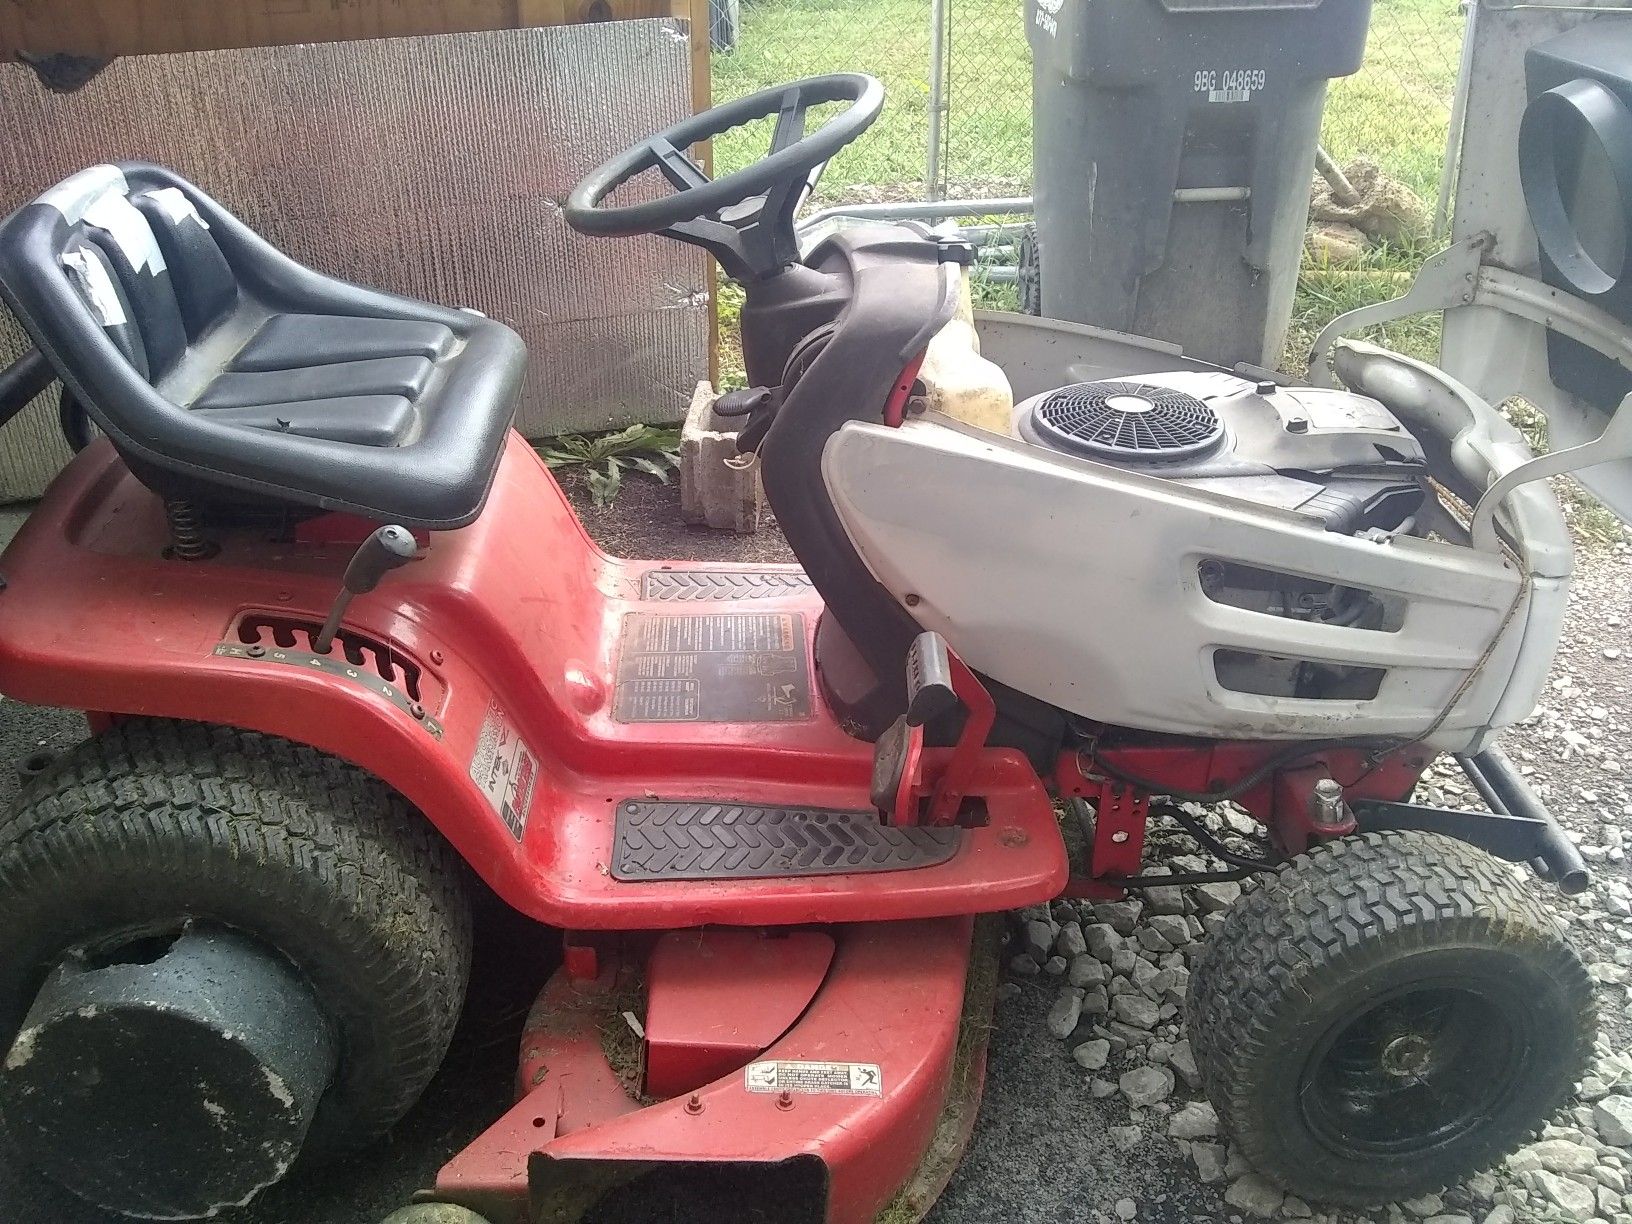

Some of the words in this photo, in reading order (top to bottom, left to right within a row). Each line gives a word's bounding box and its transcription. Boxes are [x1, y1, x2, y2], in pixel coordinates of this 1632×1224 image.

[1194, 71, 1216, 91] 9BG
[1222, 69, 1266, 91] 048659
[309, 658, 321, 667] 4
[346, 669, 358, 678] 3
[382, 686, 393, 697] 2
[488, 751, 502, 792] INTEK
